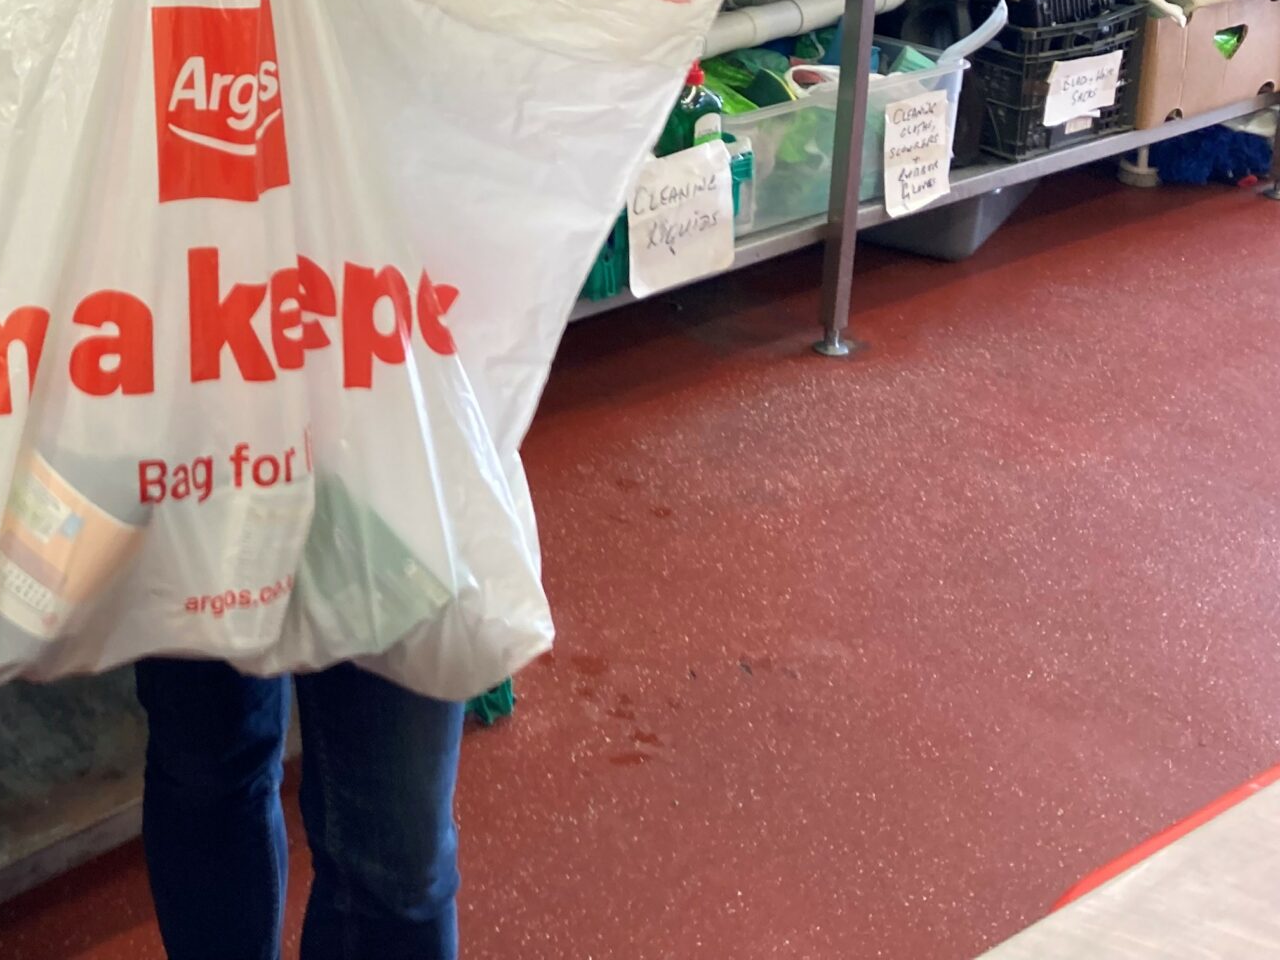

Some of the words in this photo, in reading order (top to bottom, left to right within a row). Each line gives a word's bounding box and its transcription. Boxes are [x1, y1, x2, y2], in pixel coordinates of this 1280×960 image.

[70, 289, 155, 396] a
[138, 455, 214, 505] Bag
[229, 442, 296, 488] for
